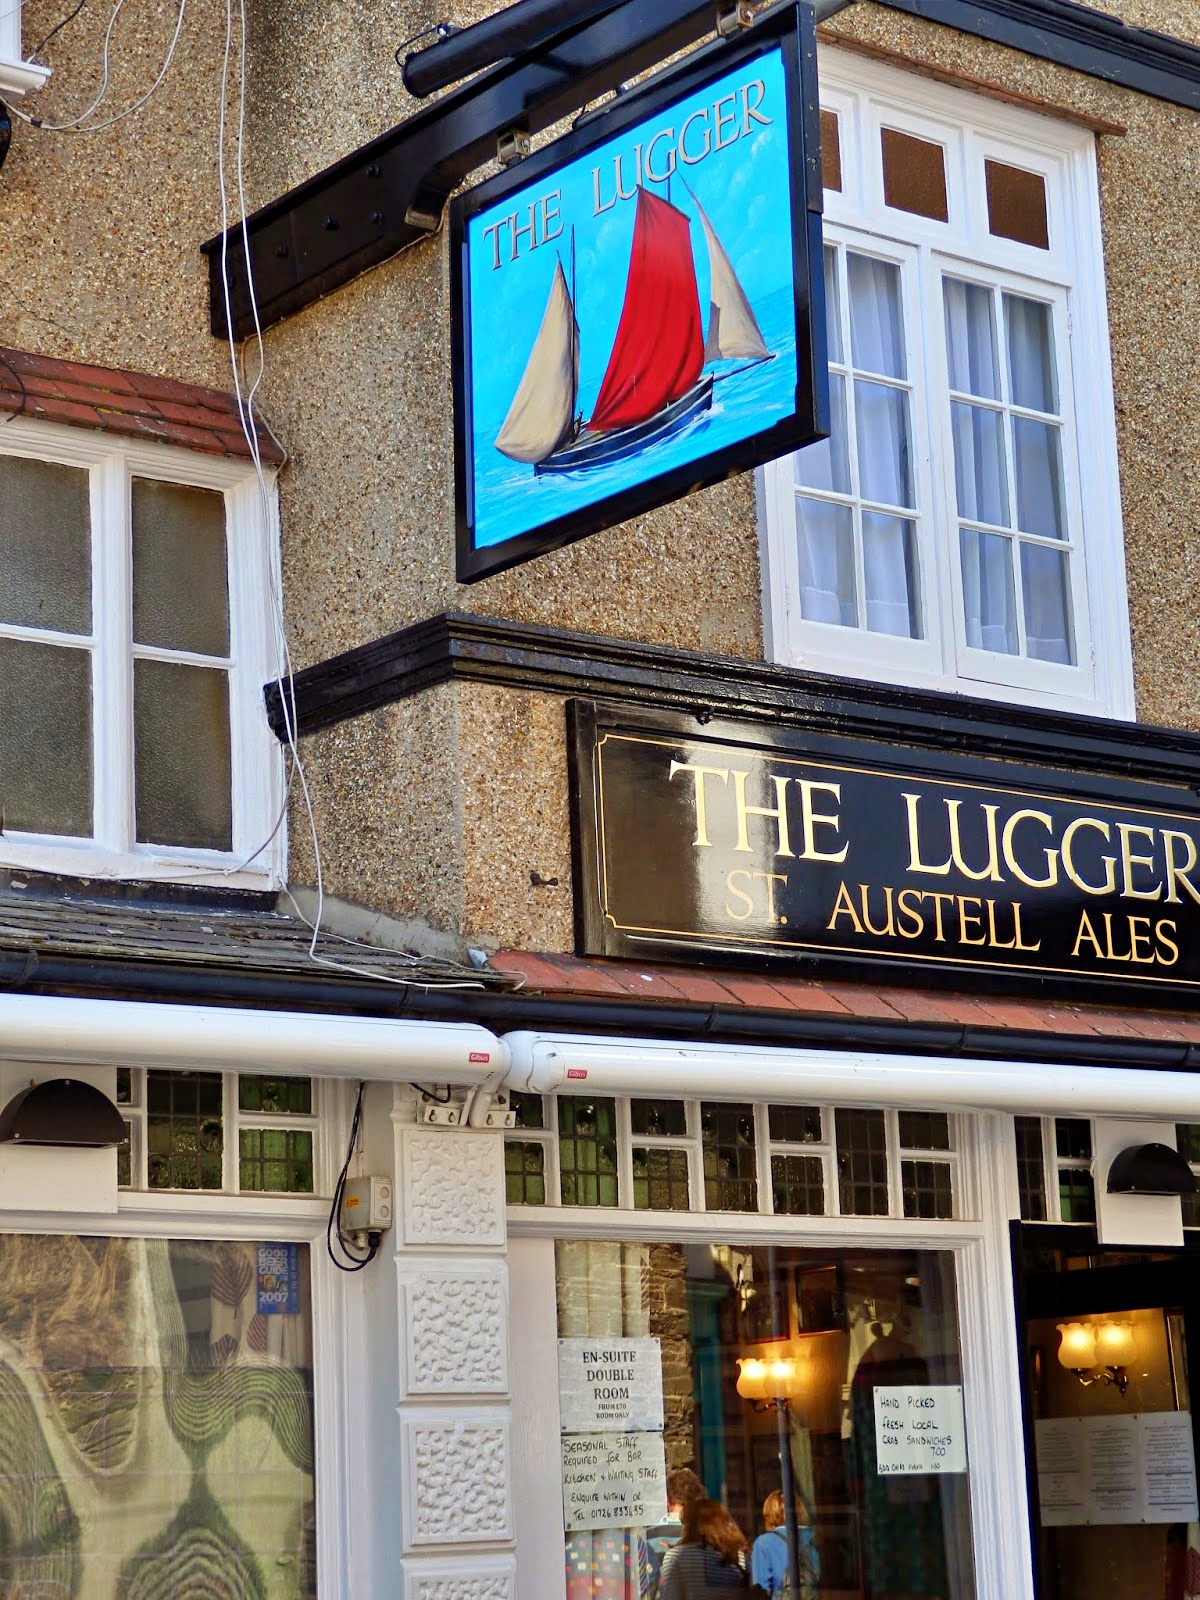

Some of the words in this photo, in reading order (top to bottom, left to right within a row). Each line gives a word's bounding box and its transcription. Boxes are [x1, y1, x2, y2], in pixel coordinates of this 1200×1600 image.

[483, 189, 566, 271] THE
[591, 79, 773, 218] LUGGER
[669, 760, 850, 864] THE
[901, 792, 1200, 906] LUGGER
[724, 870, 789, 925] ST.
[826, 880, 1041, 952] AUSTELL
[1071, 912, 1179, 967] ALES
[470, 1054, 489, 1062] Gibus
[568, 1070, 587, 1078] Gibus
[258, 1249, 288, 1257] GOOD
[258, 1257, 288, 1266] BEER
[258, 1266, 288, 1275] GUIDE
[259, 1292, 288, 1302] 2007
[582, 1351, 637, 1363] EN-SUITE
[587, 1369, 634, 1381] DOUBLE
[594, 1388, 629, 1399] ROOM
[880, 1397, 899, 1408] HAND
[907, 1396, 935, 1408] PICKED
[882, 1416, 904, 1430] FRESH
[912, 1421, 938, 1430] LOCAL
[564, 1439, 608, 1453] SEASONAL
[615, 1437, 639, 1449] STAFF
[906, 1435, 952, 1446] SANDWICHES
[563, 1455, 598, 1468] REQUIRED
[627, 1451, 642, 1462] BAR
[564, 1473, 596, 1485] KITCHEN
[603, 1492, 626, 1502] WITHIN
[632, 1492, 641, 1501] OR
[591, 1509, 611, 1519] 01726
